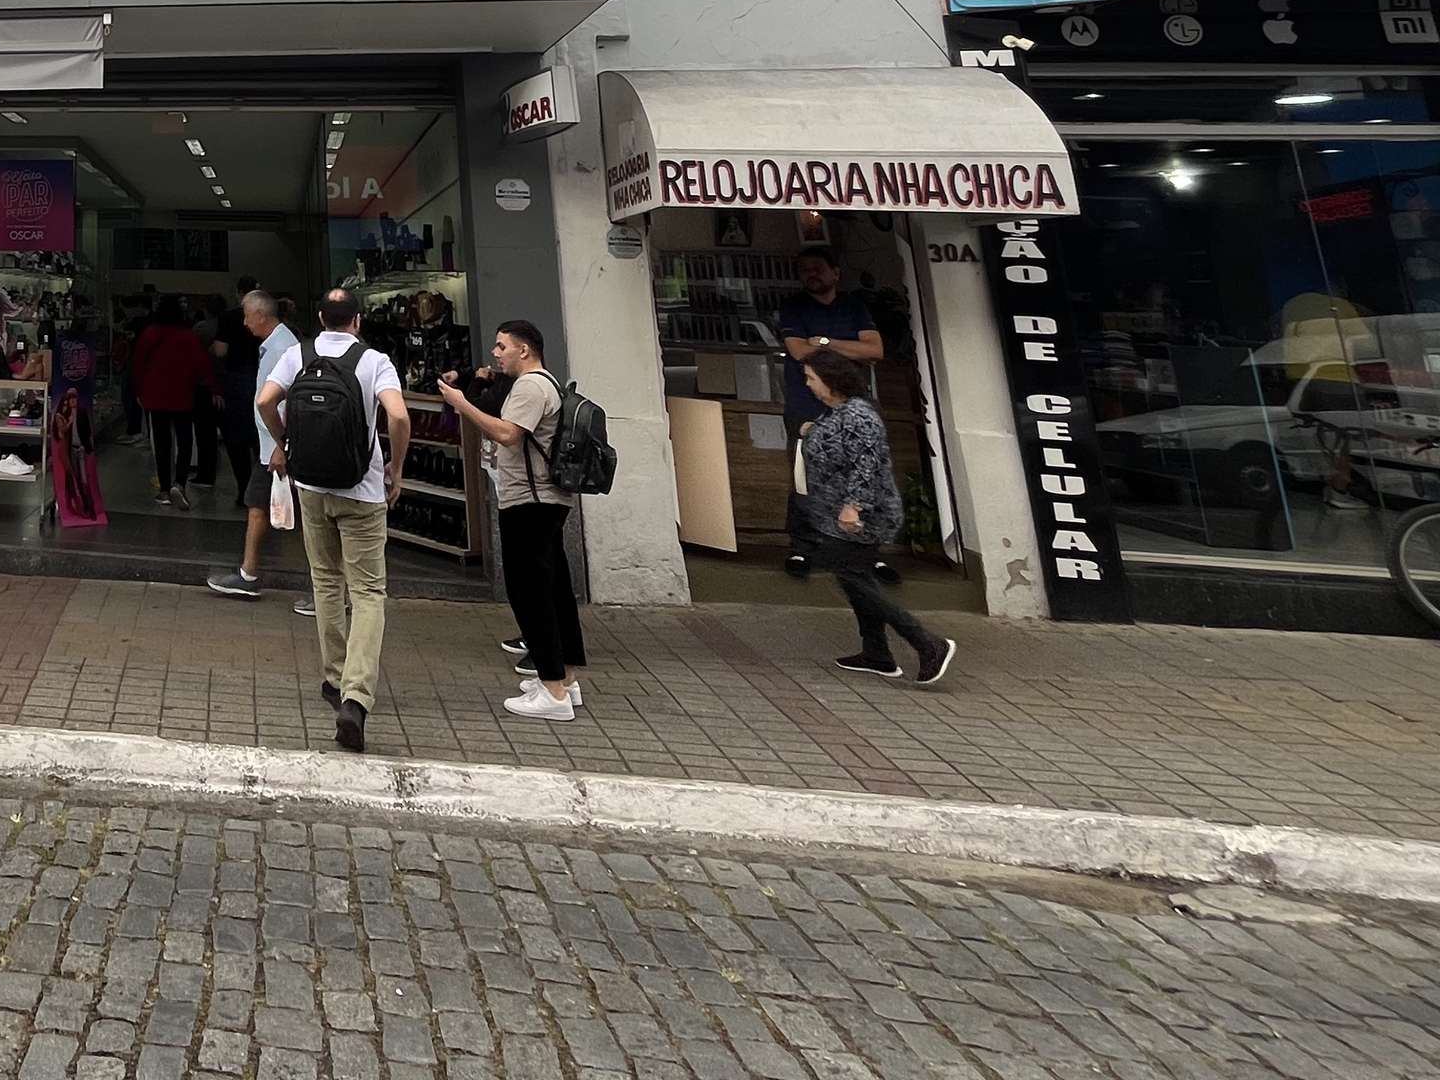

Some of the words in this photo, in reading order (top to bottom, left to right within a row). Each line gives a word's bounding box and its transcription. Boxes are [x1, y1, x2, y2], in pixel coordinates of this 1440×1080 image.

[510, 96, 553, 131] OSCAR
[6, 181, 49, 208] PAR
[8, 230, 45, 241] OSCAR
[928, 243, 978, 263] 30A
[1012, 314, 1059, 363] DE
[1025, 393, 1103, 582] CELULAR
